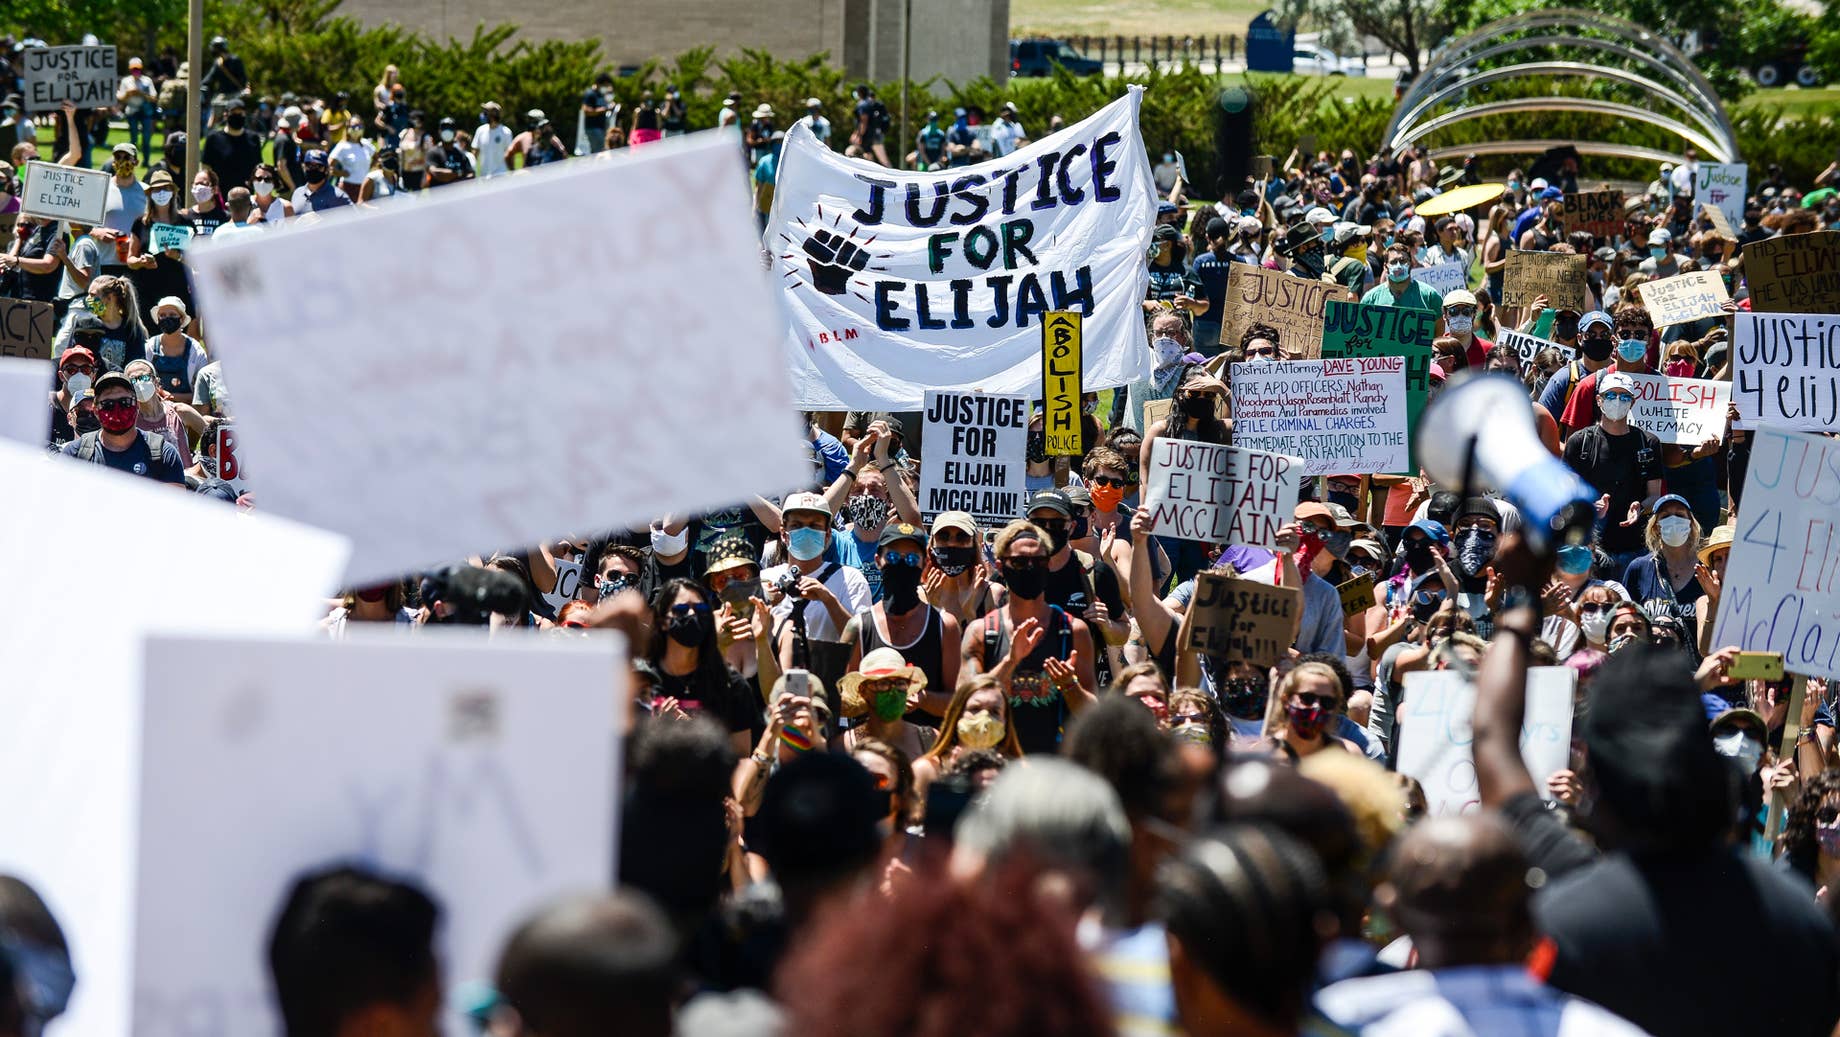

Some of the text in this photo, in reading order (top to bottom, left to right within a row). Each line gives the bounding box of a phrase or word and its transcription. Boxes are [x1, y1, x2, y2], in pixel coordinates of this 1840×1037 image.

[30, 50, 115, 72] JUSTICE
[57, 71, 80, 82] FOR
[33, 78, 114, 104] ELIJAH
[42, 170, 85, 186] JUSTICE
[53, 183, 74, 195] FOR
[852, 132, 1121, 227] JUSTICE
[39, 193, 80, 209] ELIJAH
[929, 218, 1040, 273] FOR
[874, 264, 1095, 332] ELIJAH
[1648, 276, 1708, 298] JUSTICE
[1325, 302, 1435, 348] JUSTICE
[1048, 317, 1076, 431] ABOLISH
[1232, 362, 1273, 376] District
[1324, 358, 1354, 374] DAVE
[1357, 357, 1403, 372] YOUNG
[1264, 381, 1289, 395] APD
[1347, 378, 1384, 392] Nathan
[1740, 370, 1764, 417] 4
[1353, 391, 1388, 406] Randy
[927, 394, 1025, 428] JUSTICE
[1234, 405, 1276, 418] Roedema
[1278, 405, 1297, 418] And
[1298, 404, 1349, 416] Paramedics
[1640, 406, 1689, 419] WHITE
[1271, 417, 1322, 432] CRIMINAL
[951, 427, 997, 457] FOR
[1047, 434, 1080, 450] POLICE
[1300, 433, 1365, 448] RESTITUTION
[1367, 432, 1381, 446] TO
[1381, 431, 1404, 446] THE
[1321, 445, 1364, 460] FAMILY
[944, 461, 1006, 488] ELIJAH
[1159, 442, 1290, 486] JUSTICE FOR
[1304, 459, 1338, 475] Right
[929, 488, 1018, 516] MCCLAIN!
[1168, 473, 1280, 514] ELIJAH
[1150, 503, 1283, 547] MCCLAIN
[1743, 508, 1787, 584] 4
